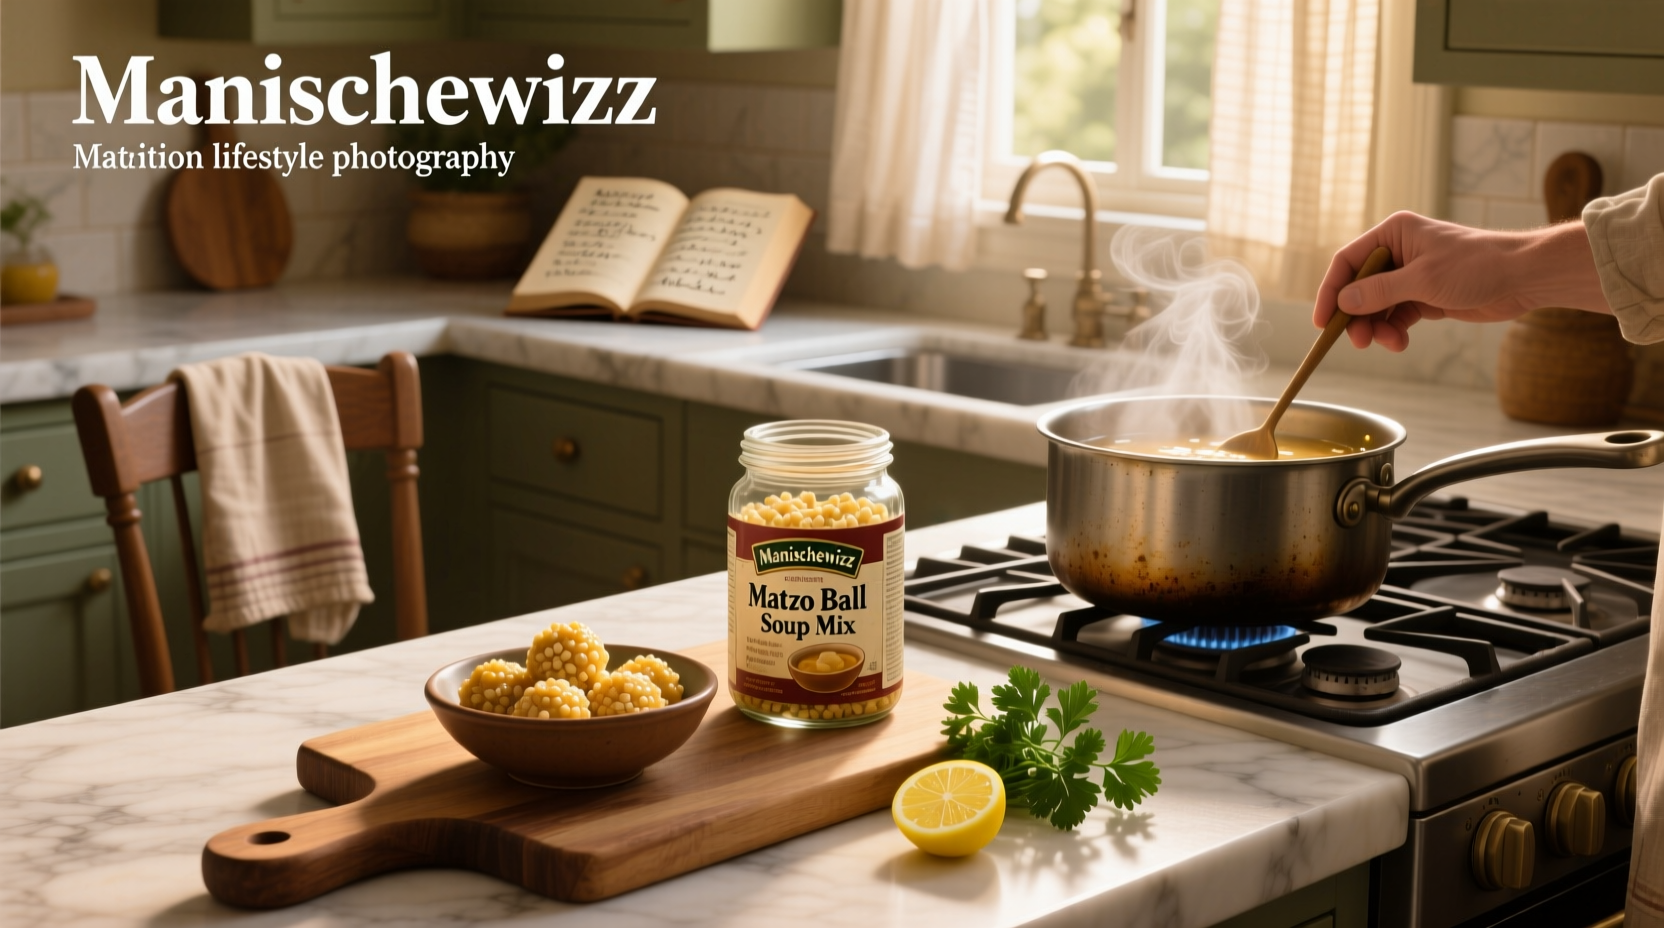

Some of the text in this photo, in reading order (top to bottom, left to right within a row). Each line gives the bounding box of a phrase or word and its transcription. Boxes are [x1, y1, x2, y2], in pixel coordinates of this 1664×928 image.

[748, 582, 867, 611] Matzo Ball
[760, 612, 856, 640] Soup Mix
